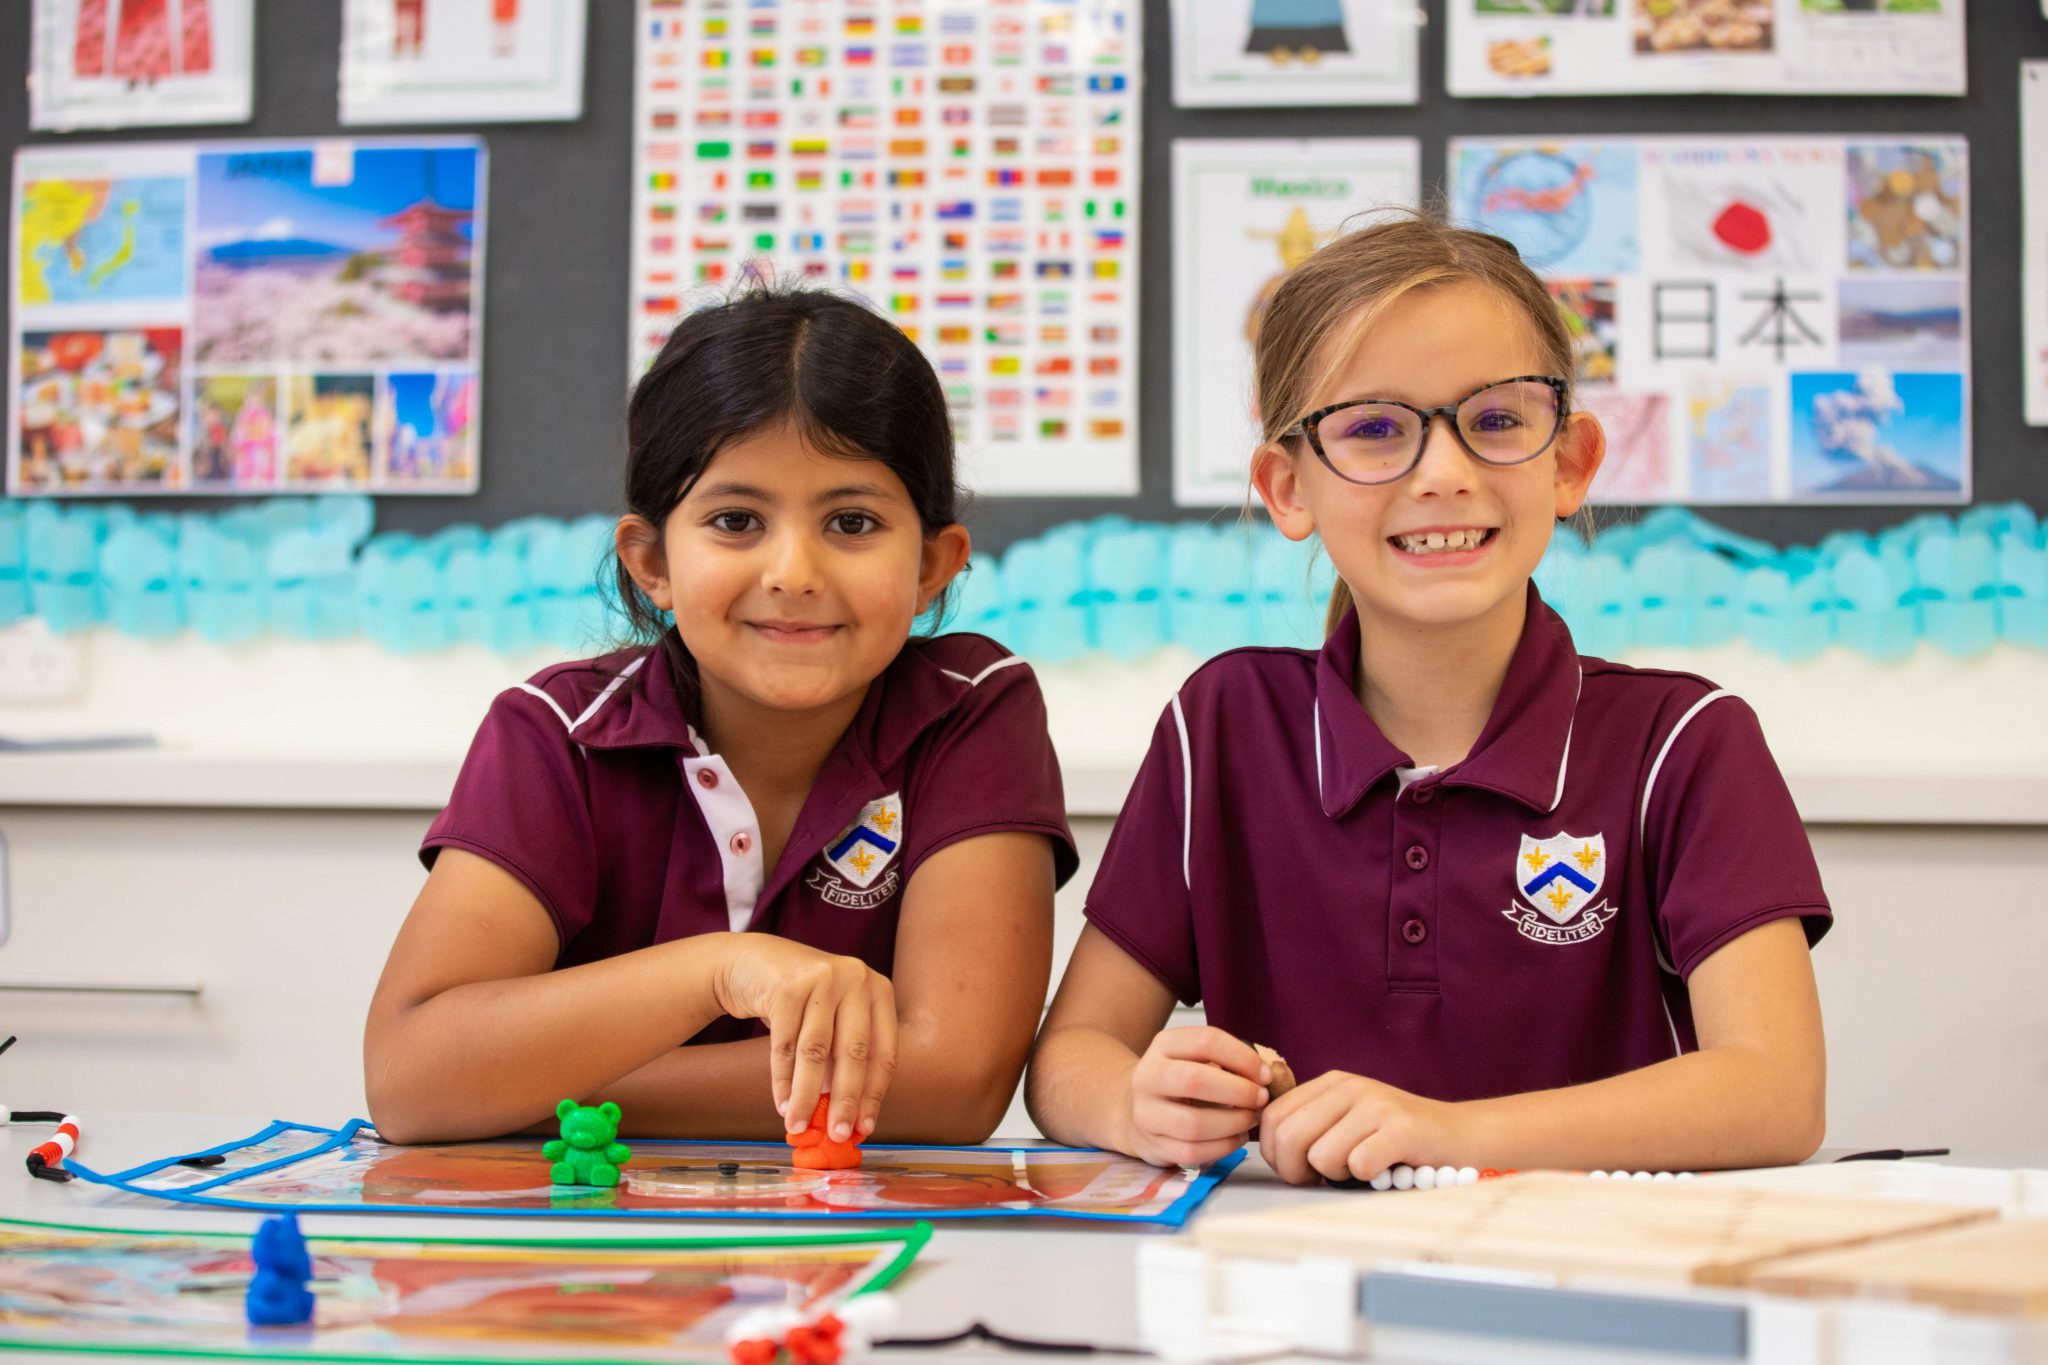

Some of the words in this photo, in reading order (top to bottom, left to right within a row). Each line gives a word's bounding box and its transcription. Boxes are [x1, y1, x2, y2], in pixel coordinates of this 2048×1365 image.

[1250, 176, 1349, 198] Mexico
[1652, 276, 1823, 361] 日本
[826, 879, 899, 907] FIDELITER
[1522, 920, 1601, 942] FIDELITER
